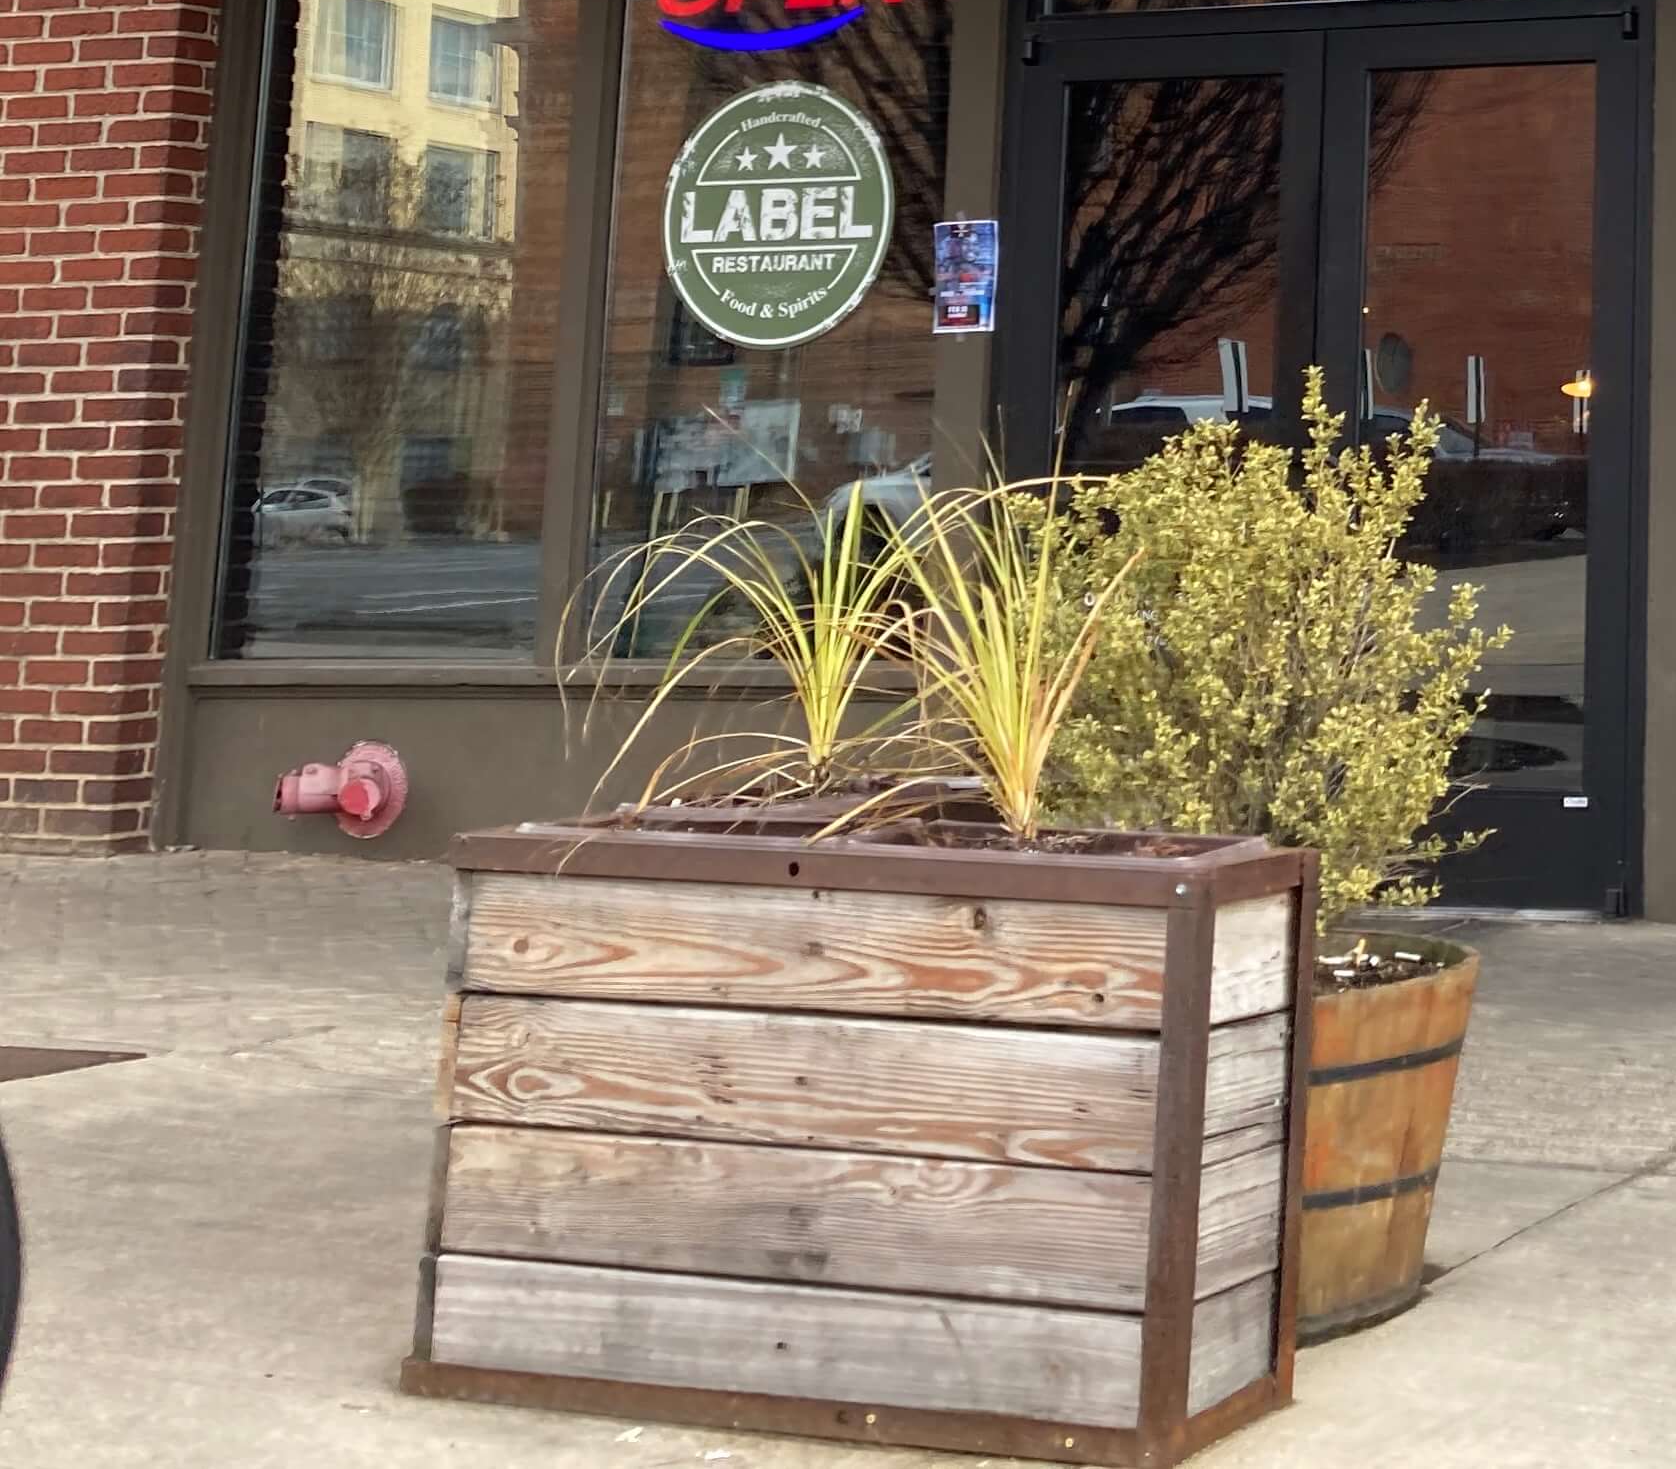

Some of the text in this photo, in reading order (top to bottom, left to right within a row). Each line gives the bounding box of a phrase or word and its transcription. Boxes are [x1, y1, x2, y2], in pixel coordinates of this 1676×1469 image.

[741, 112, 822, 132] Handcrafted
[680, 187, 873, 243] LABEL
[712, 253, 836, 274] RESTAURANT
[719, 289, 828, 319] Food & Spirits
